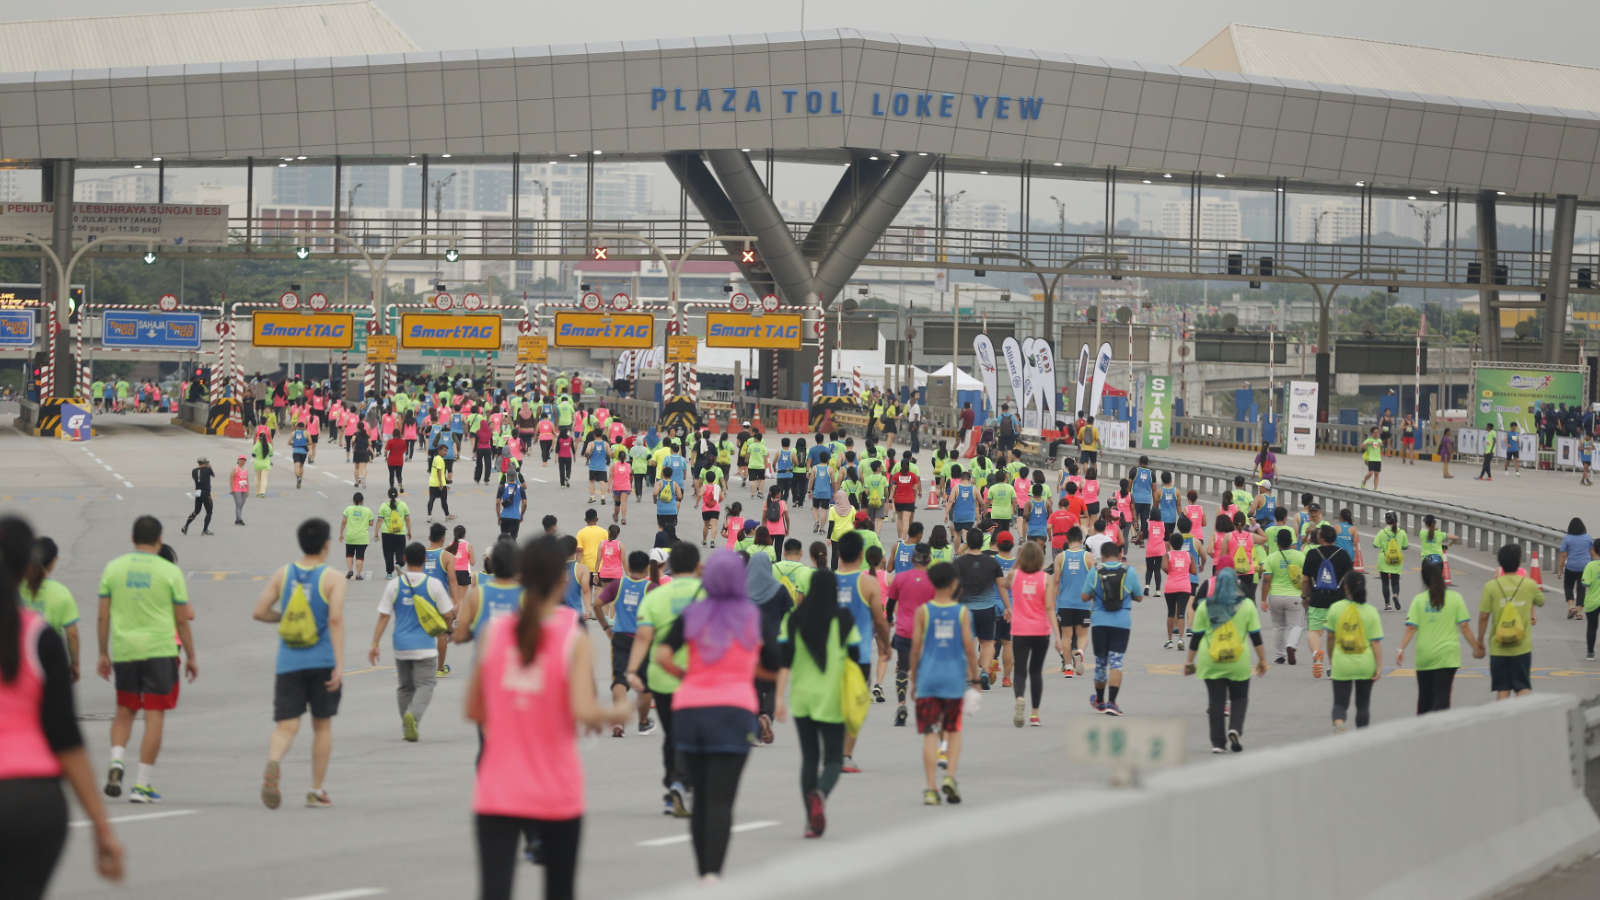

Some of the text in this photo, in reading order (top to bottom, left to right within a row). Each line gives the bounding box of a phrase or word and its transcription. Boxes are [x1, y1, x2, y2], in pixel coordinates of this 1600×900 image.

[650, 87, 1044, 121] PLAZA TOL LOKE YEW
[79, 205, 146, 214] LEBUHRAYA
[150, 206, 192, 216] SUNGAI
[195, 207, 221, 216] BESI
[1149, 378, 1166, 448] START
